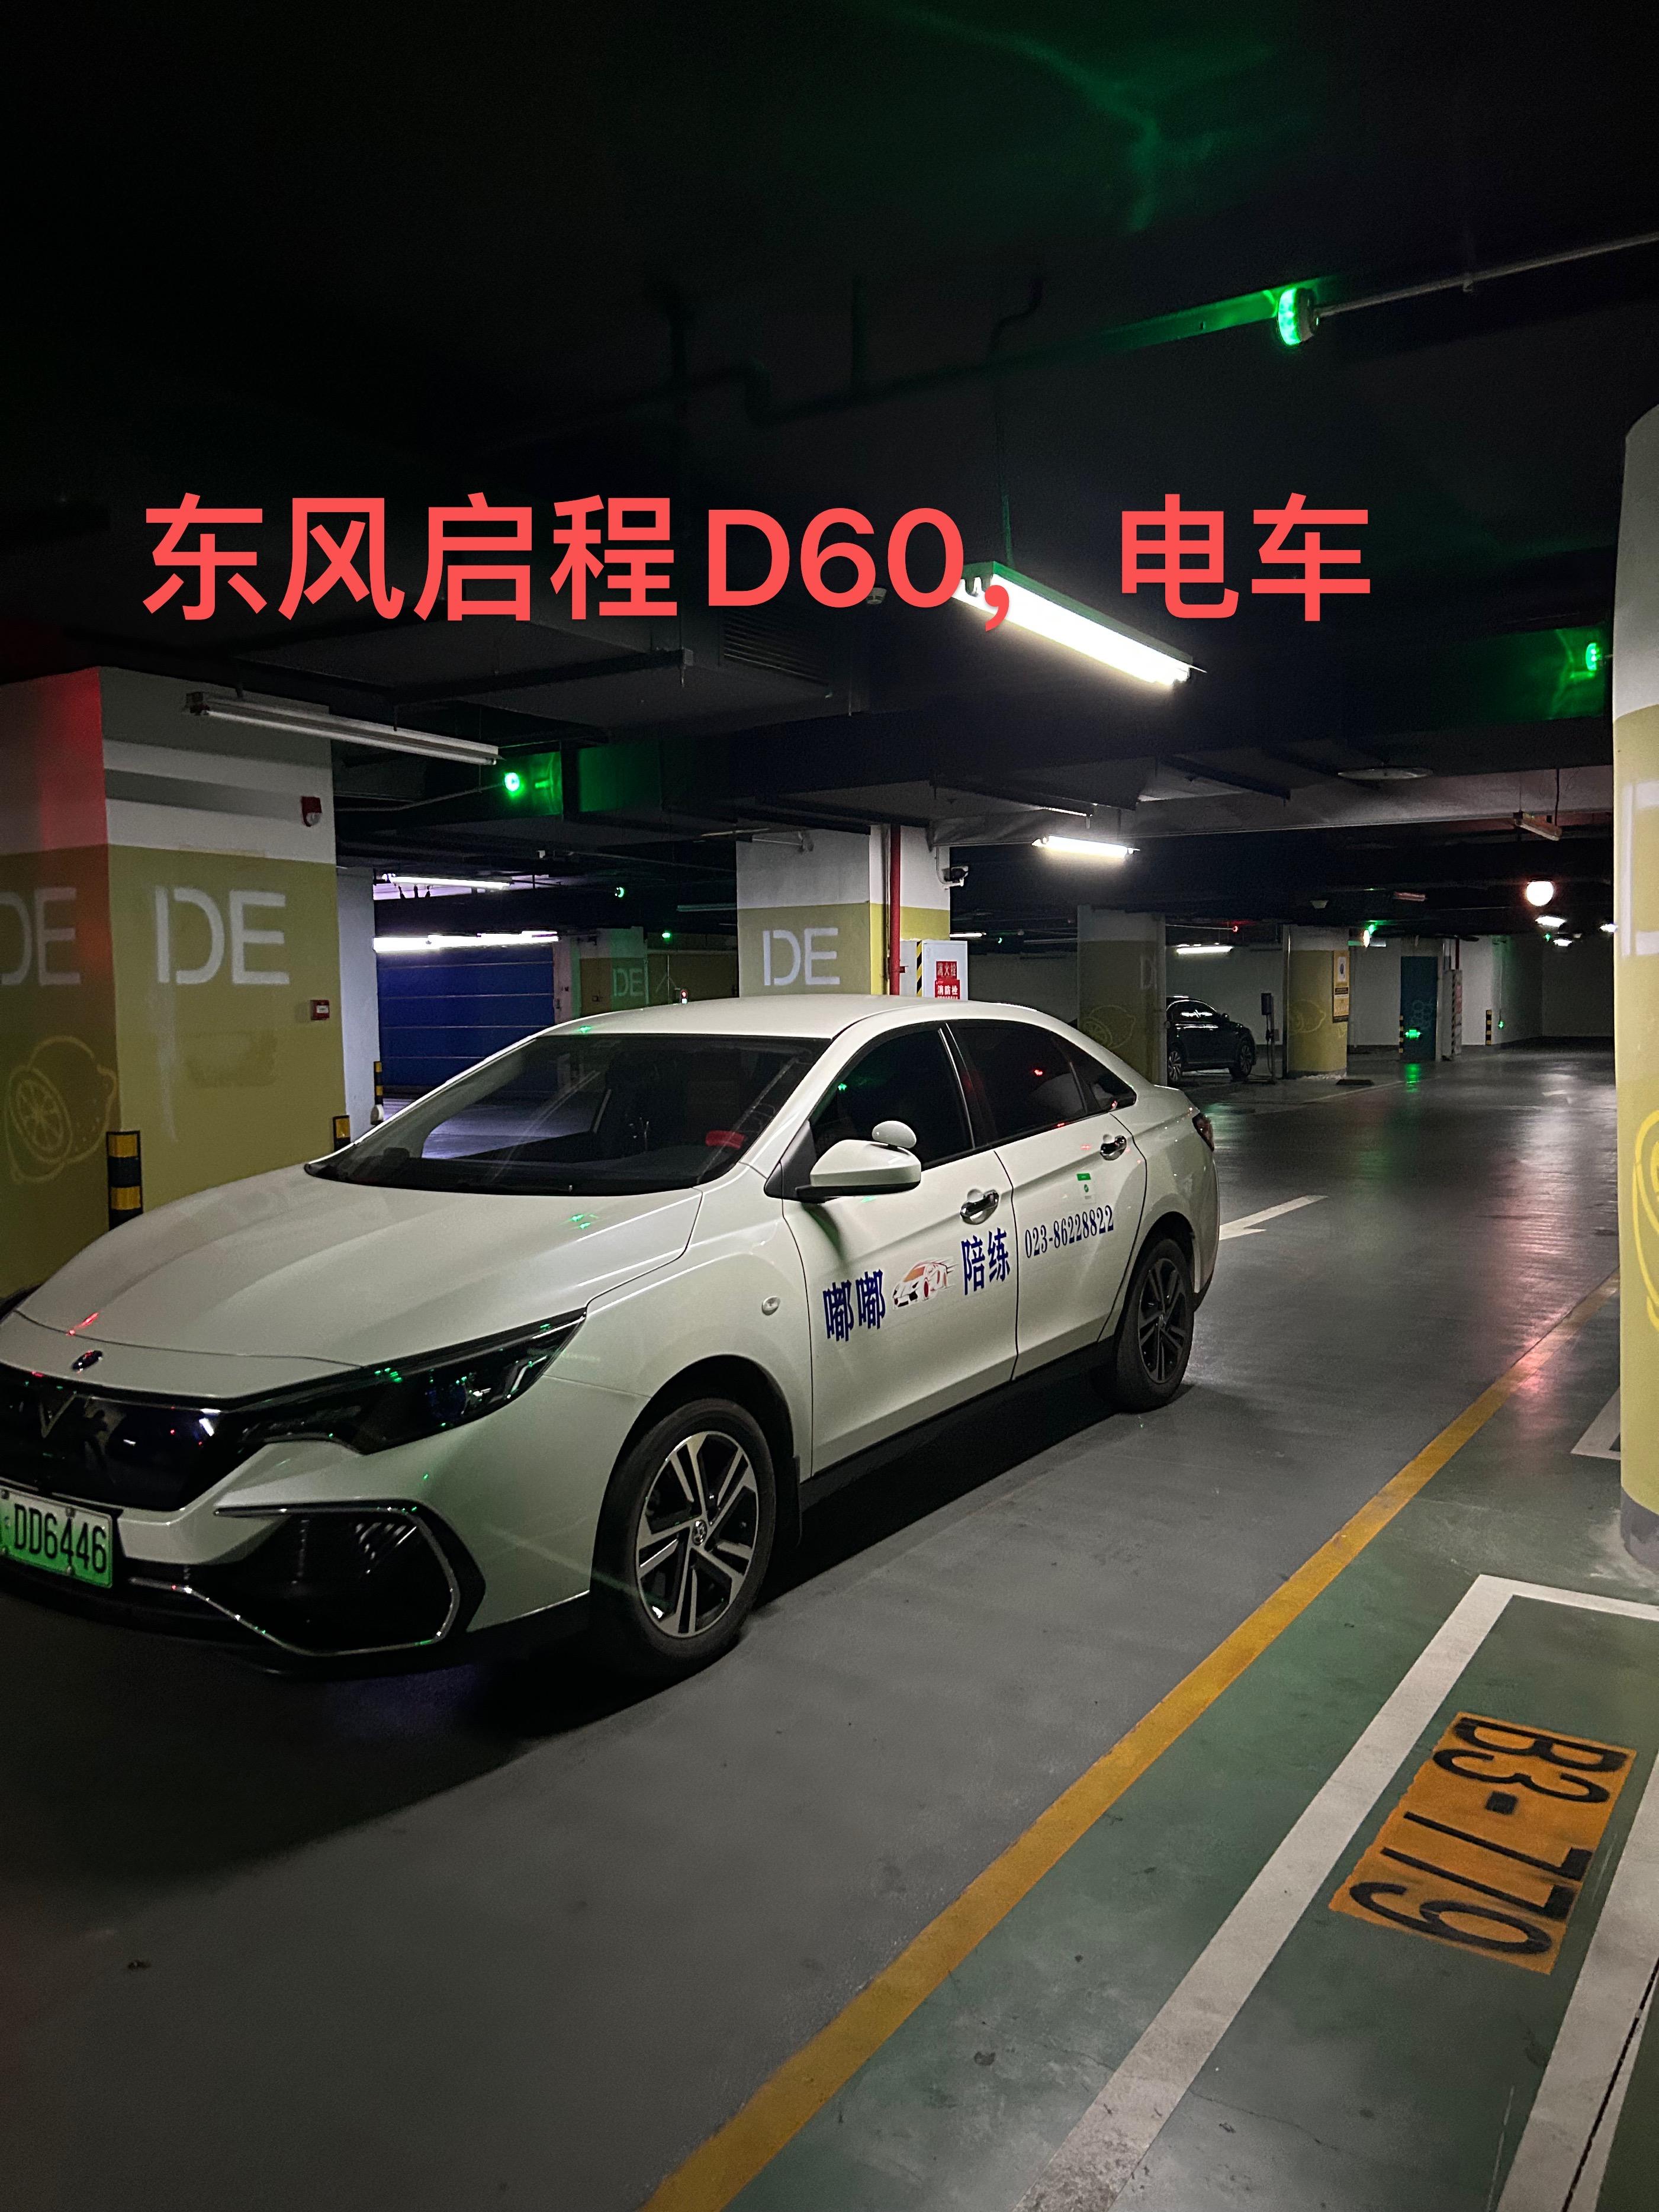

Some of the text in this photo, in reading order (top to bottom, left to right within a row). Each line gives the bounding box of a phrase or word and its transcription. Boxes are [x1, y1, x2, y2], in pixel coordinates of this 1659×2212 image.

[155, 886, 290, 985] DE
[763, 928, 840, 986] DE
[613, 968, 644, 996] DE
[937, 962, 956, 976] 消火栓
[937, 985, 958, 995] 消防栓
[1025, 1205, 1114, 1258] 023-86228822
[823, 1227, 1011, 1342] 嘟嘟 陪练
[14, 1503, 107, 1574] DD6446
[1349, 1717, 1630, 1954] B3-779
